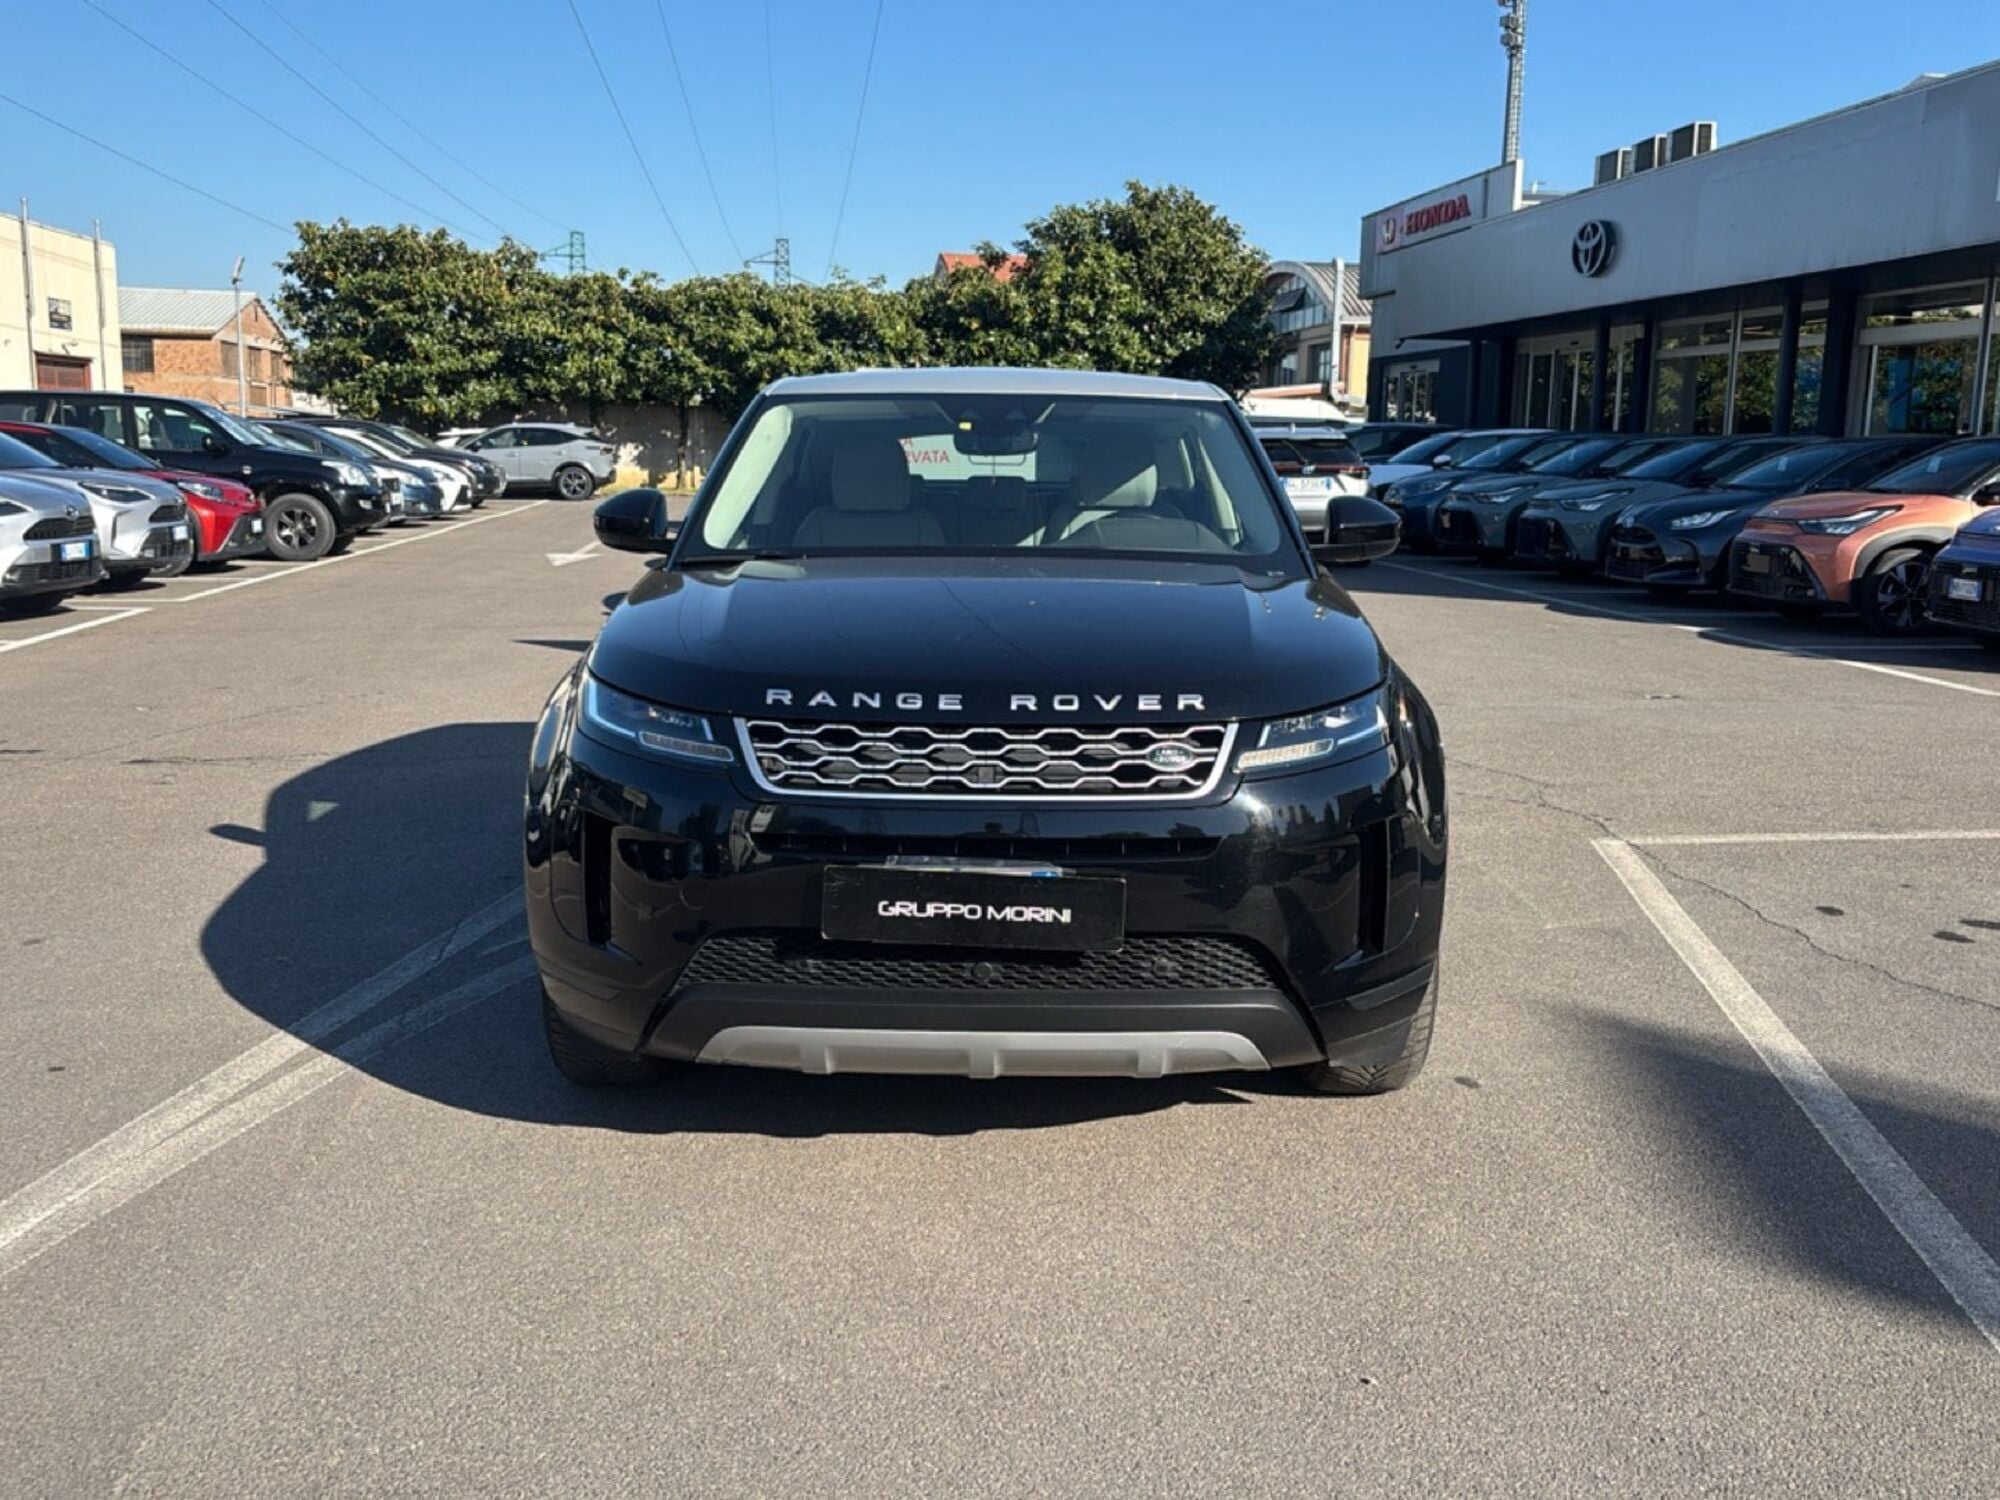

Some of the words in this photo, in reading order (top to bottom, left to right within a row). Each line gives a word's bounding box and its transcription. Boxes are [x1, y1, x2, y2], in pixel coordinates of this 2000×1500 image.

[1405, 194, 1471, 235] HONDA
[766, 690, 963, 710] RANGE
[1010, 694, 1205, 711] ROVER
[878, 901, 982, 919] GRUPPO
[987, 905, 1071, 923] MORINI
